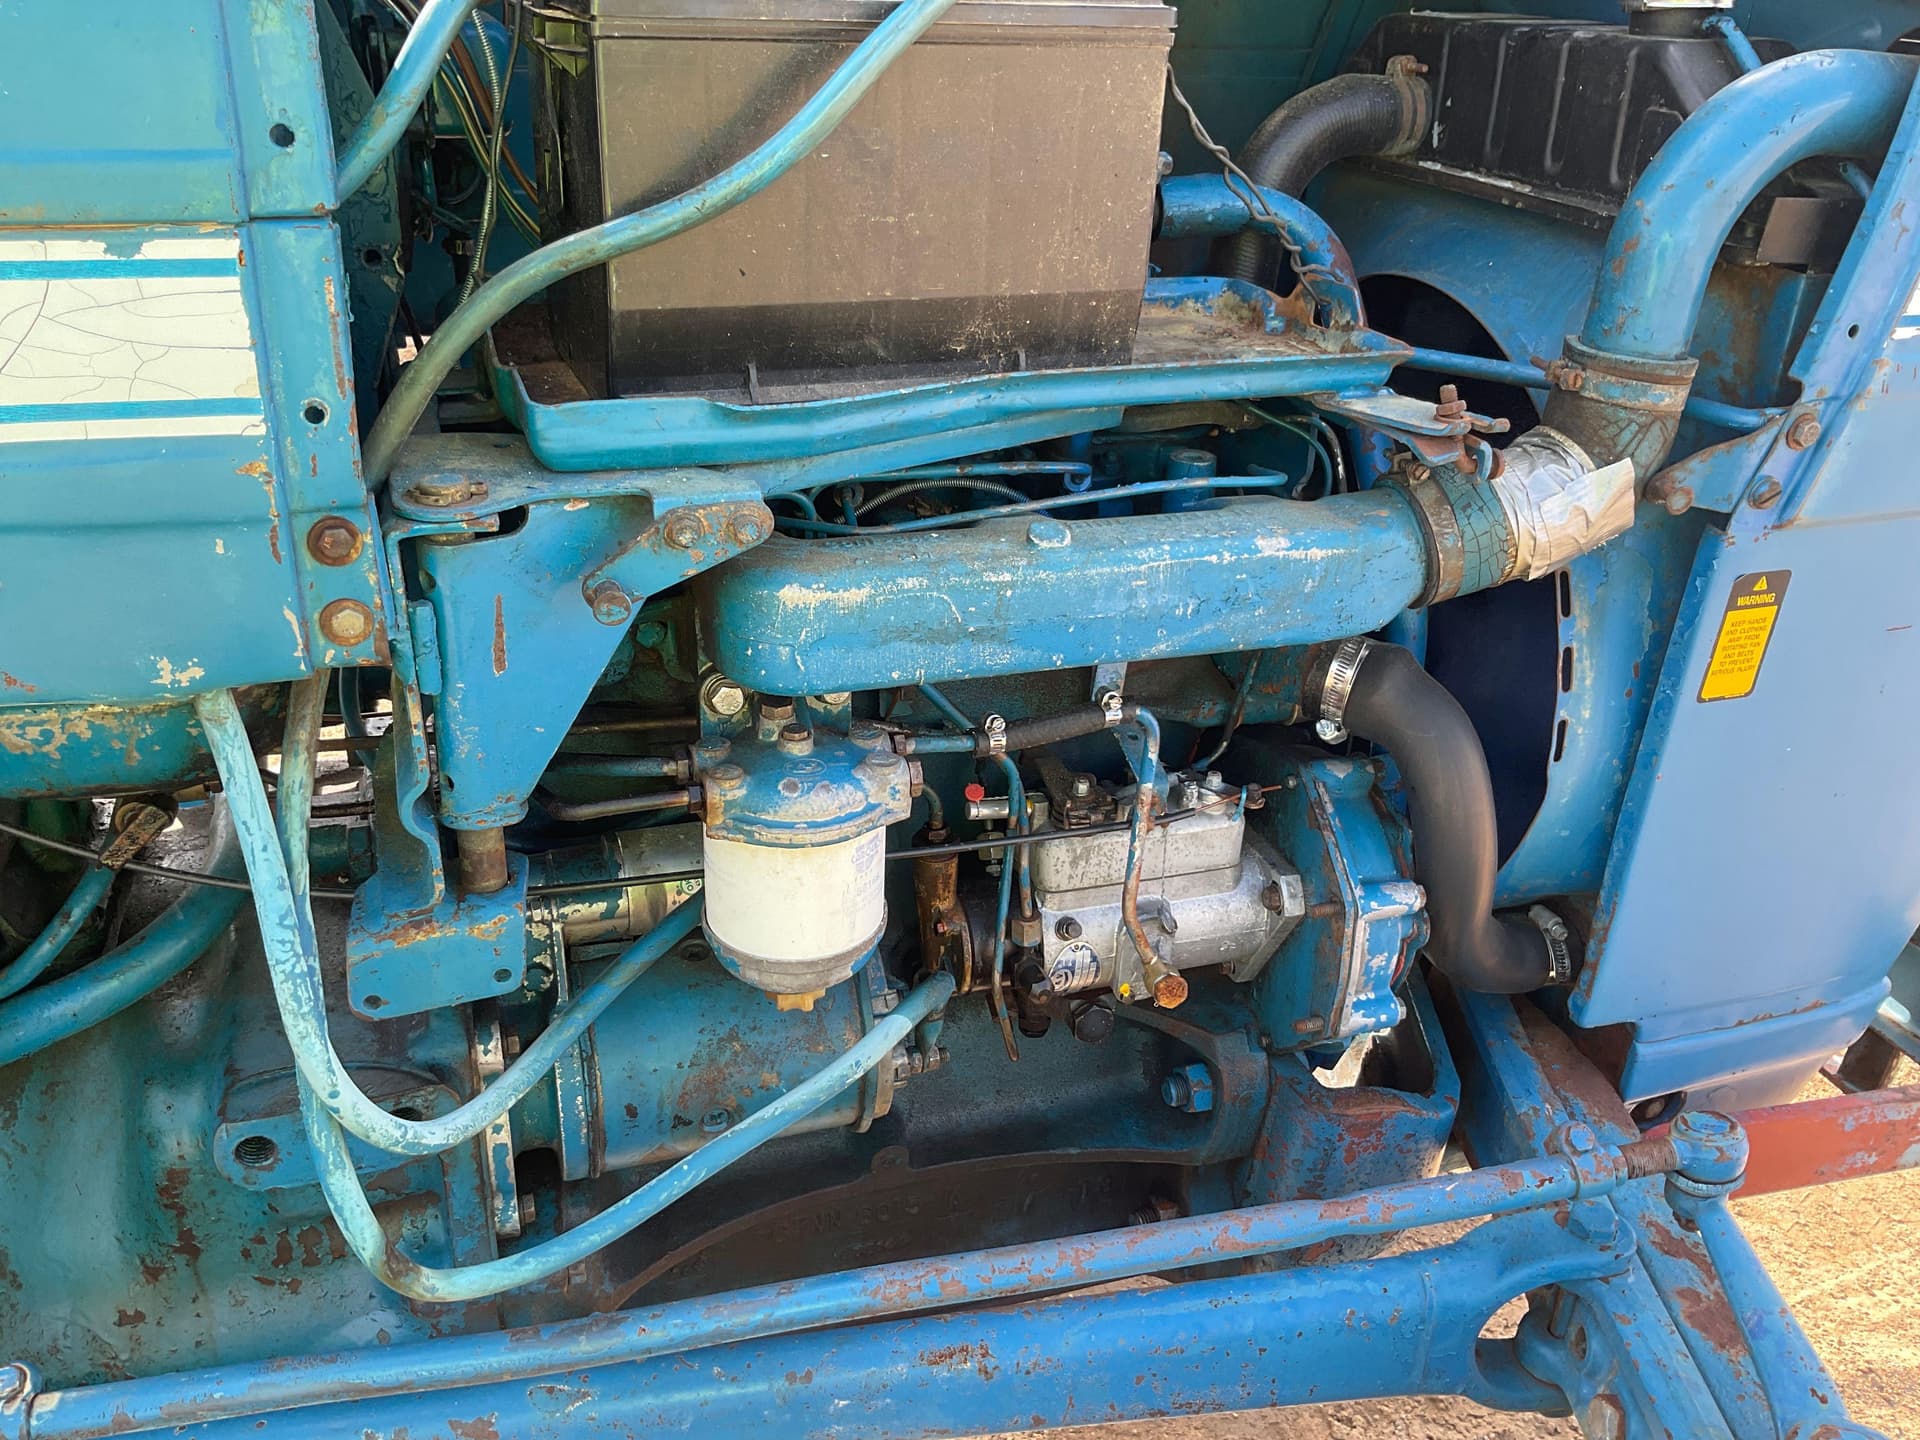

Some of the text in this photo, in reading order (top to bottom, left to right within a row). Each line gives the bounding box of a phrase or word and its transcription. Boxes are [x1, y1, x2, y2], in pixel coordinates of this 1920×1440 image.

[1737, 593, 1776, 607] WARNING
[1739, 625, 1767, 634] CLOTHING
[1721, 643, 1748, 651] ROTATING
[1728, 657, 1754, 665] PREVENT
[1737, 664, 1755, 672] INJURY
